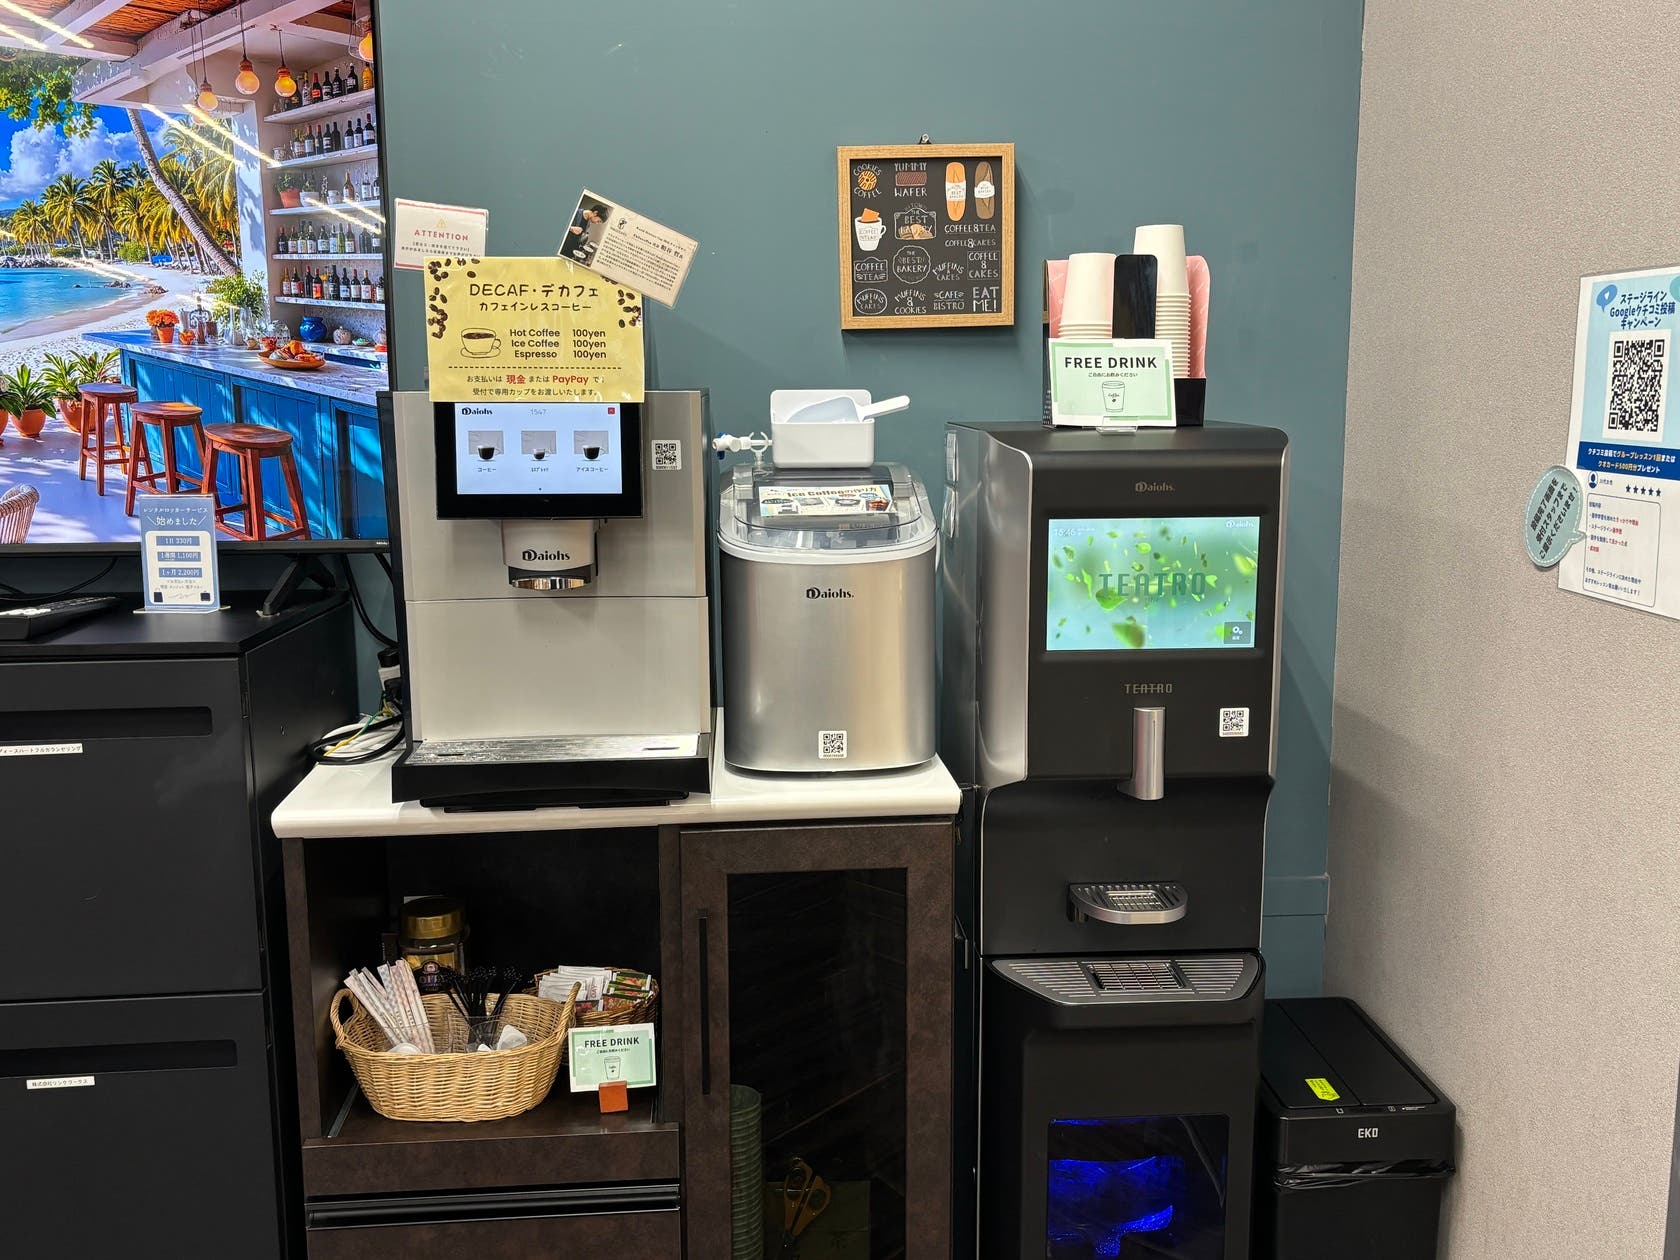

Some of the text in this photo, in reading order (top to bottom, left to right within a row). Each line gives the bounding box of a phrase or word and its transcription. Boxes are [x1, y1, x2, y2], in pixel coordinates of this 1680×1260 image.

[853, 162, 882, 177] COOKIES
[894, 162, 927, 171] YUMMY
[853, 188, 882, 199] COFFEE
[894, 187, 927, 197] WAFER
[904, 216, 928, 224] BEST
[414, 229, 469, 241] ATTENTION
[968, 252, 998, 261] COFFEE
[855, 262, 885, 272] COFFEE
[897, 265, 928, 273] BAKERY
[932, 262, 965, 275] MUFFINS
[936, 273, 961, 281] CAKES
[968, 269, 998, 279] CAKES
[894, 289, 926, 302] MUFFINS
[939, 290, 959, 299] CAFE
[972, 286, 999, 299] EAT
[1620, 290, 1667, 305] ステージライン
[479, 301, 592, 312] カフェインレスコーヒー
[894, 306, 927, 314] COOKIES
[933, 301, 965, 310] BISTRO
[973, 300, 998, 312] ME!
[1609, 301, 1676, 319] Googleクチコミ投稿
[1620, 317, 1662, 330] キャンペーン
[509, 328, 606, 340] Hot Coffee 100yen
[511, 339, 606, 350] Ice Coffee 100yen
[514, 350, 607, 361] Espresso 100yen
[1065, 357, 1157, 369] FREE DRINK
[467, 375, 503, 383] お支払いは
[506, 374, 526, 385] 現金
[552, 375, 589, 385] PayPay
[472, 388, 598, 396] 受付で専用カップをお渡しいたします。
[461, 407, 493, 416] Daiohs
[1536, 482, 1567, 544] 受付スタッフまで
[156, 516, 198, 526] 始めました
[522, 549, 570, 561] Daiohs
[1099, 573, 1206, 597] TEATRO
[1124, 684, 1173, 694] TEATRO
[584, 1036, 640, 1048] FREE DRINK
[1358, 1127, 1379, 1139] EKO
